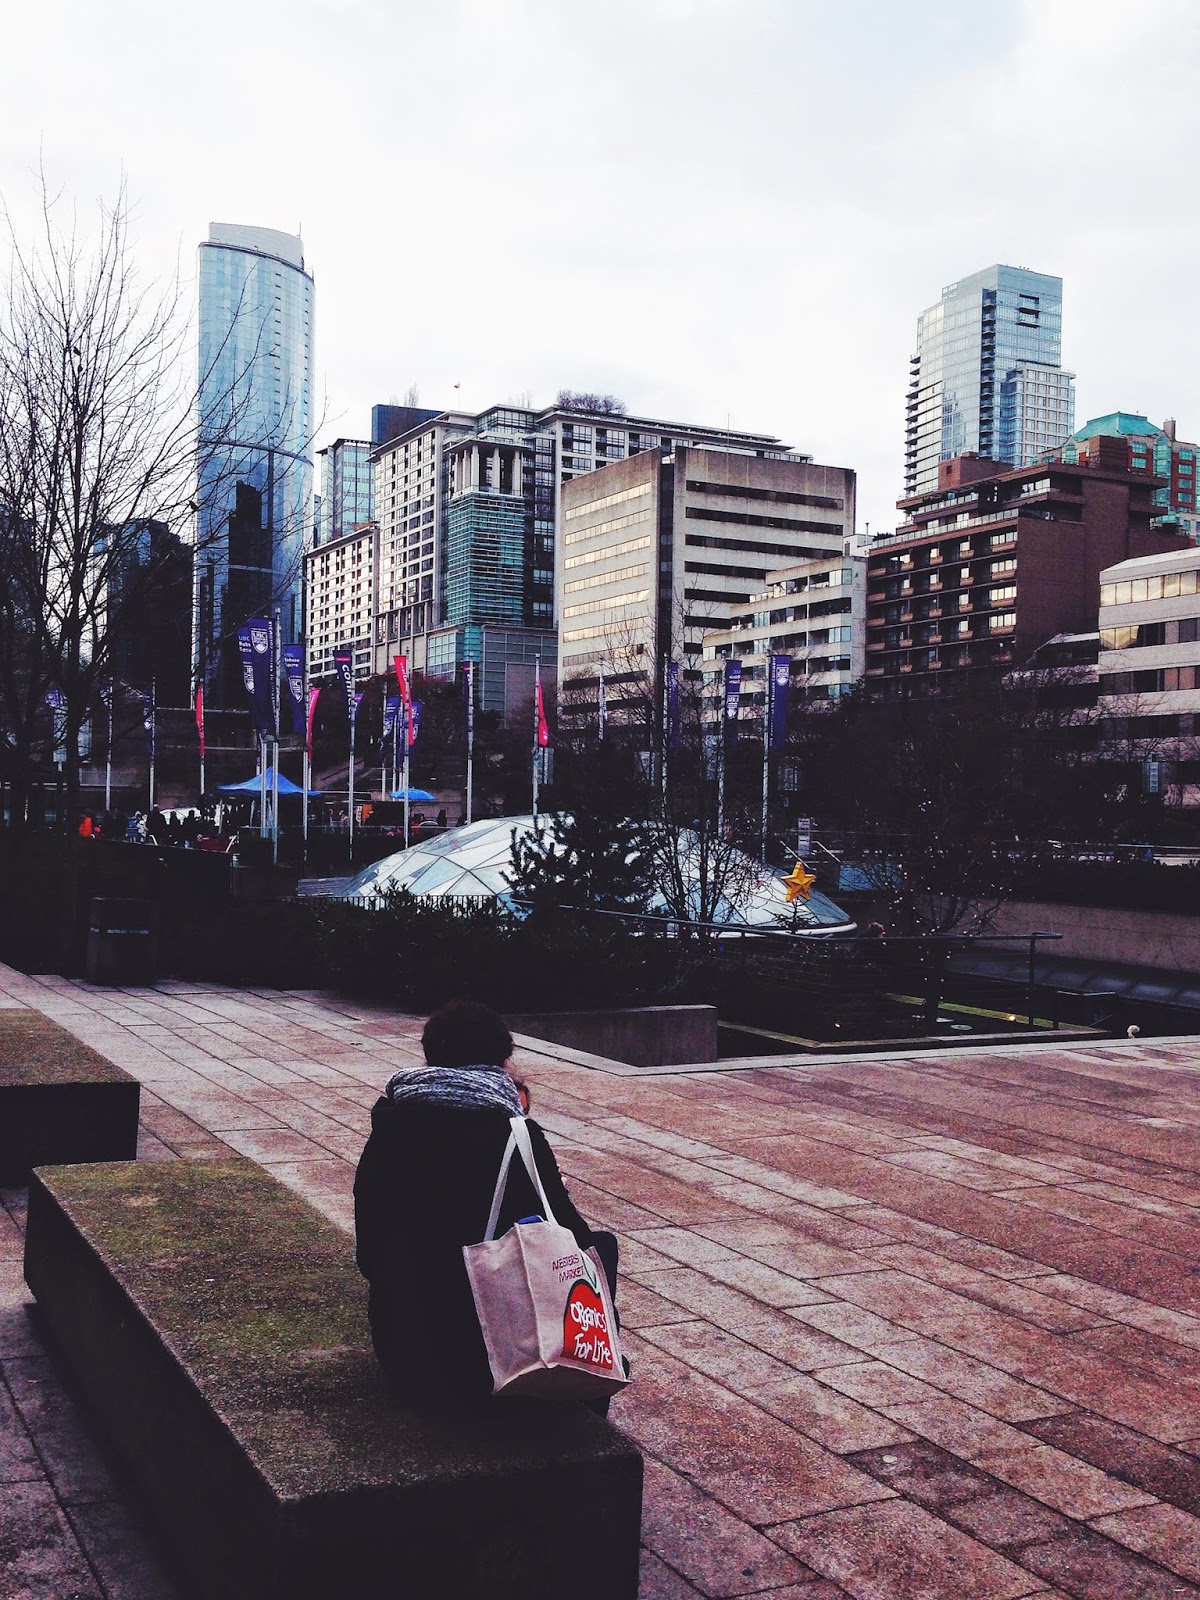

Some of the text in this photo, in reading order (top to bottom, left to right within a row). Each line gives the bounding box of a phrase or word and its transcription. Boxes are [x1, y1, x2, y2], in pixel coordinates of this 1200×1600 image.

[552, 1254, 579, 1271] NESTERS
[558, 1266, 584, 1282] MARKET
[574, 1333, 593, 1359] For
[592, 1335, 612, 1364] Life
